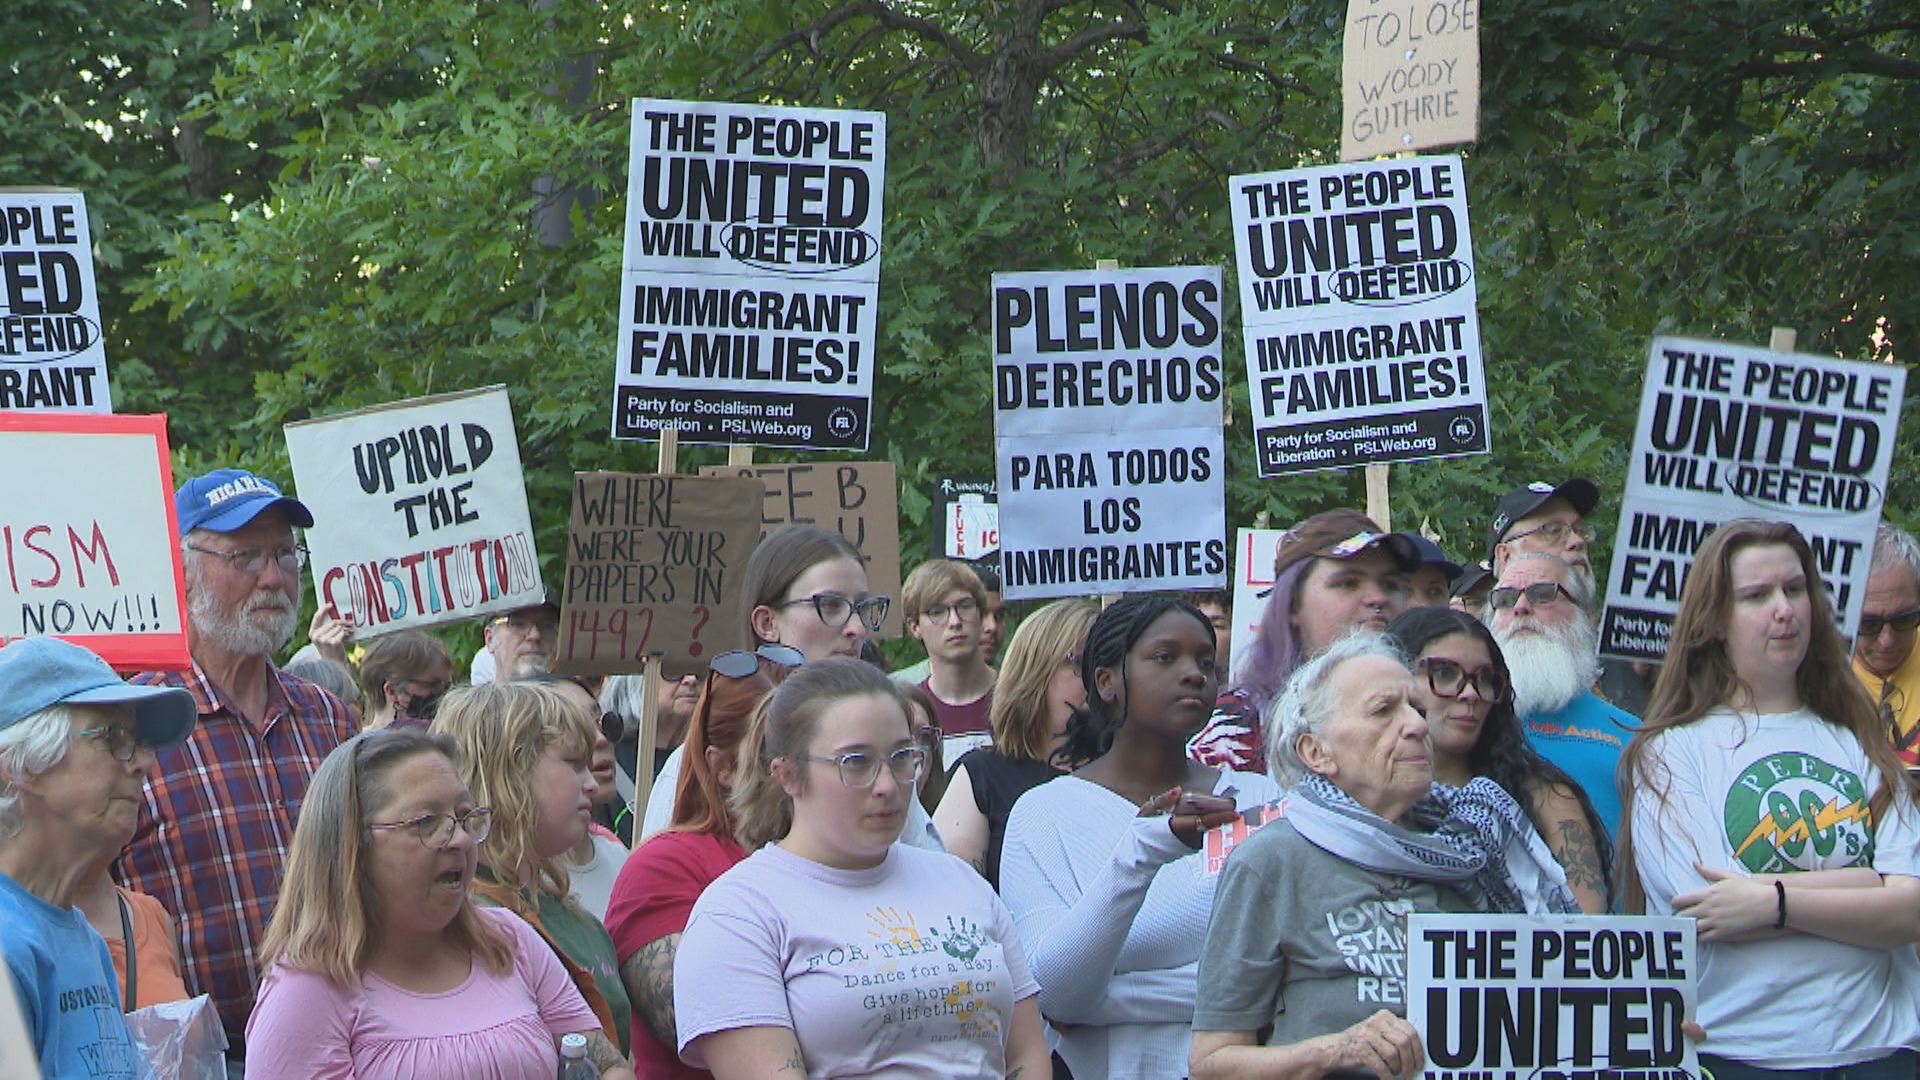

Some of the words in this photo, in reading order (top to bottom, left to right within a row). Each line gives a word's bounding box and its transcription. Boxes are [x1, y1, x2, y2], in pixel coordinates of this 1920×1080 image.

[1355, 12, 1401, 50] TO
[1408, 0, 1474, 40] LOSE
[1359, 57, 1458, 105] WOODY
[645, 111, 716, 154] THE
[727, 115, 873, 162] PEOPLE
[1351, 89, 1459, 142] GUTHRIE
[643, 155, 870, 229] UNITED
[1241, 179, 1311, 219] THE
[1320, 165, 1454, 211] PEOPLE
[640, 221, 720, 258] WILL
[727, 225, 868, 265] DEFEND
[1248, 204, 1458, 278] UNITED
[0, 251, 83, 316] ED
[1252, 275, 1331, 312] WILL
[1335, 260, 1462, 302] DEFEND
[633, 285, 866, 335] IMMIGRANT
[996, 279, 1218, 354] PLENOS
[0, 316, 90, 357] FEND
[630, 330, 860, 385] FAMILIES!
[1256, 316, 1466, 372] IMMIGRANT
[627, 396, 666, 415] Party
[670, 399, 690, 413] for
[694, 400, 762, 416] Socialism
[765, 403, 794, 417] and
[996, 355, 1221, 410] DERECHOS
[1261, 355, 1470, 418] FAMILIES!
[1663, 350, 1735, 393] THE
[1743, 360, 1892, 414] PEOPLE
[626, 415, 701, 432] Liberation
[721, 419, 812, 440] PSLWeb.org
[1266, 434, 1301, 451] Party
[1303, 431, 1324, 445] for
[1325, 425, 1390, 441] Socialism
[1392, 420, 1418, 435] and
[1268, 446, 1336, 465] Liberation
[1354, 436, 1437, 456] PSLWeb.org
[1650, 391, 1880, 477] UNITED
[352, 423, 494, 494] UPHOLD
[1011, 453, 1098, 491] PARA
[1107, 447, 1211, 486] TODOS
[1645, 452, 1724, 494] WILL
[1734, 465, 1871, 512] DEFEND
[394, 481, 479, 538] THE
[579, 477, 683, 528] WHERE
[1083, 497, 1142, 535] LOS
[3, 519, 121, 594] ISM
[572, 528, 644, 562] WERE
[657, 531, 727, 568] YOUR
[1004, 539, 1225, 587] INMIGRANTES
[322, 532, 537, 628] CONSTITUTION
[567, 565, 675, 605] PAPERS
[693, 567, 723, 605] IN
[22, 593, 161, 635] NOW!!!
[1614, 614, 1651, 636] Party
[1741, 757, 1852, 795] PEER
[806, 944, 869, 973] FOR
[875, 937, 938, 959] THE
[844, 971, 906, 988] Dance
[912, 964, 940, 979] for
[948, 962, 958, 973] a
[1423, 929, 1517, 980] THE
[1531, 929, 1686, 980] PEOPLE
[863, 993, 910, 1010] Give
[916, 984, 960, 1001] hope
[965, 979, 993, 996] for
[883, 1013, 894, 1025] a
[1426, 986, 1685, 1069] UNITED
